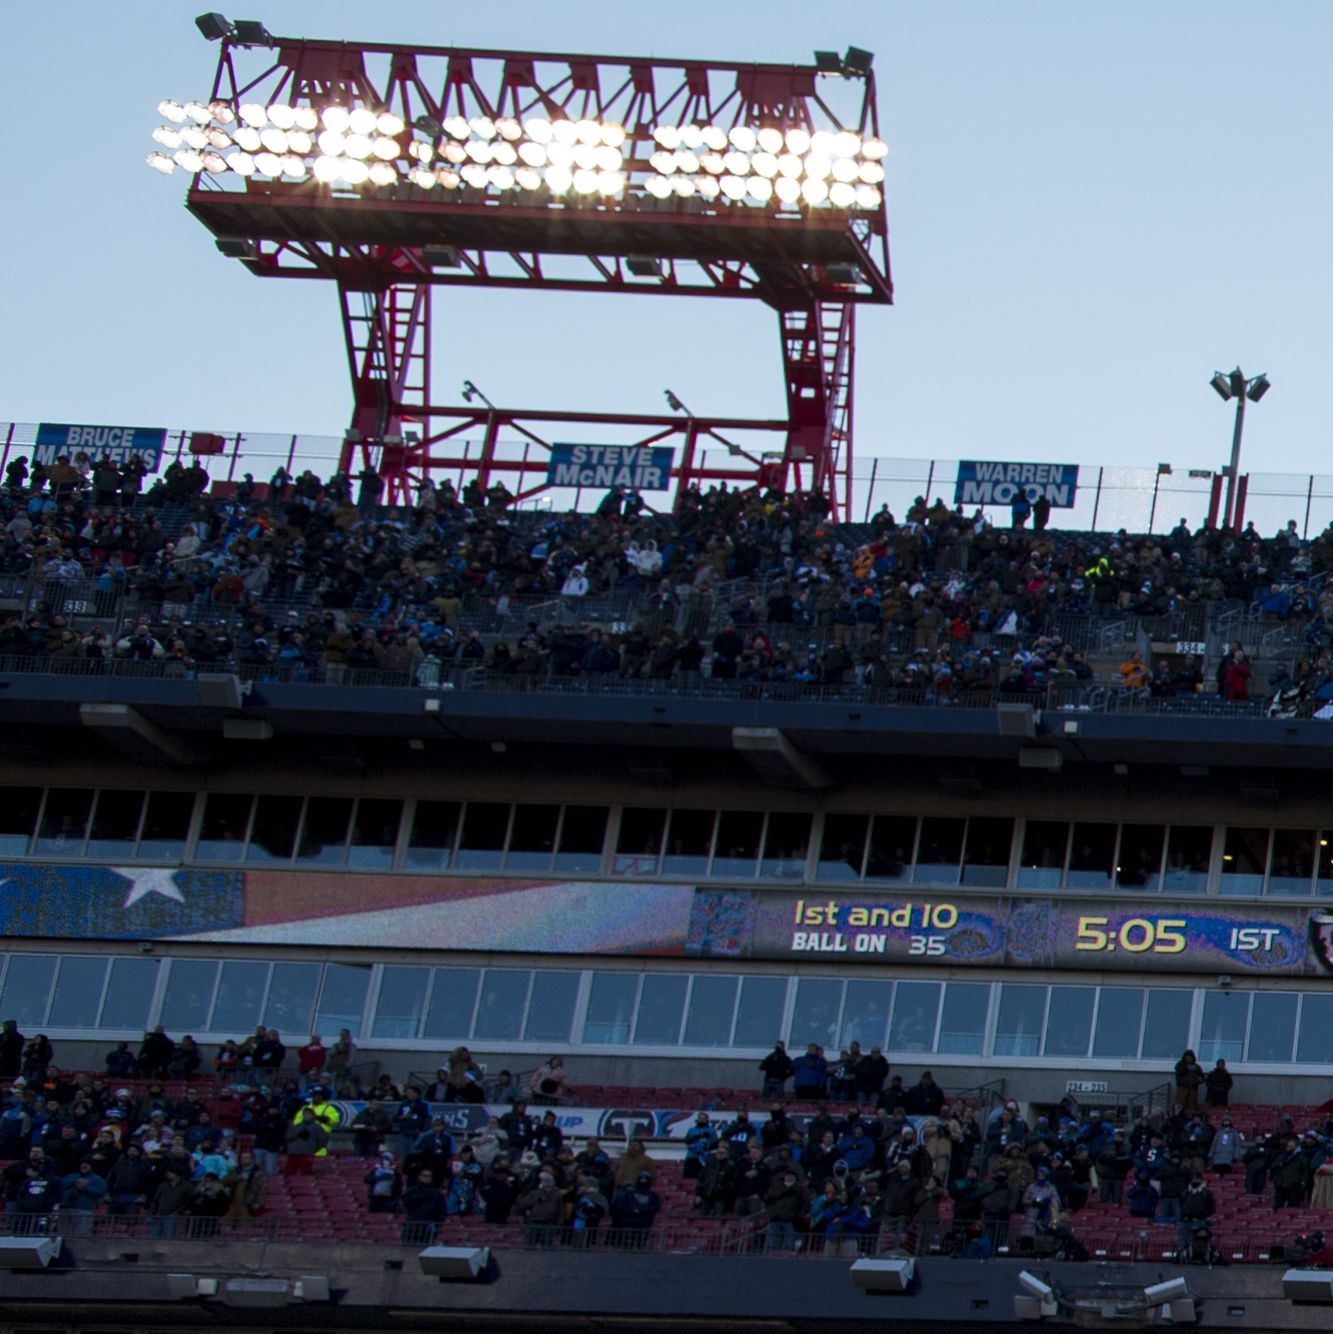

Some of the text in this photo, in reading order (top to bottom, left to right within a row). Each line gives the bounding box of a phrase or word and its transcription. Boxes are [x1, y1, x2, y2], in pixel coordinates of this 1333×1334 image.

[67, 426, 135, 447] BRUCE
[570, 445, 654, 466] STEVE
[555, 463, 662, 489] McNAIR
[975, 462, 1063, 484] WARREN
[963, 481, 1069, 506] MOON
[848, 904, 912, 928] and
[792, 932, 945, 955] BALL ON 35
[1076, 917, 1186, 953] 5:05
